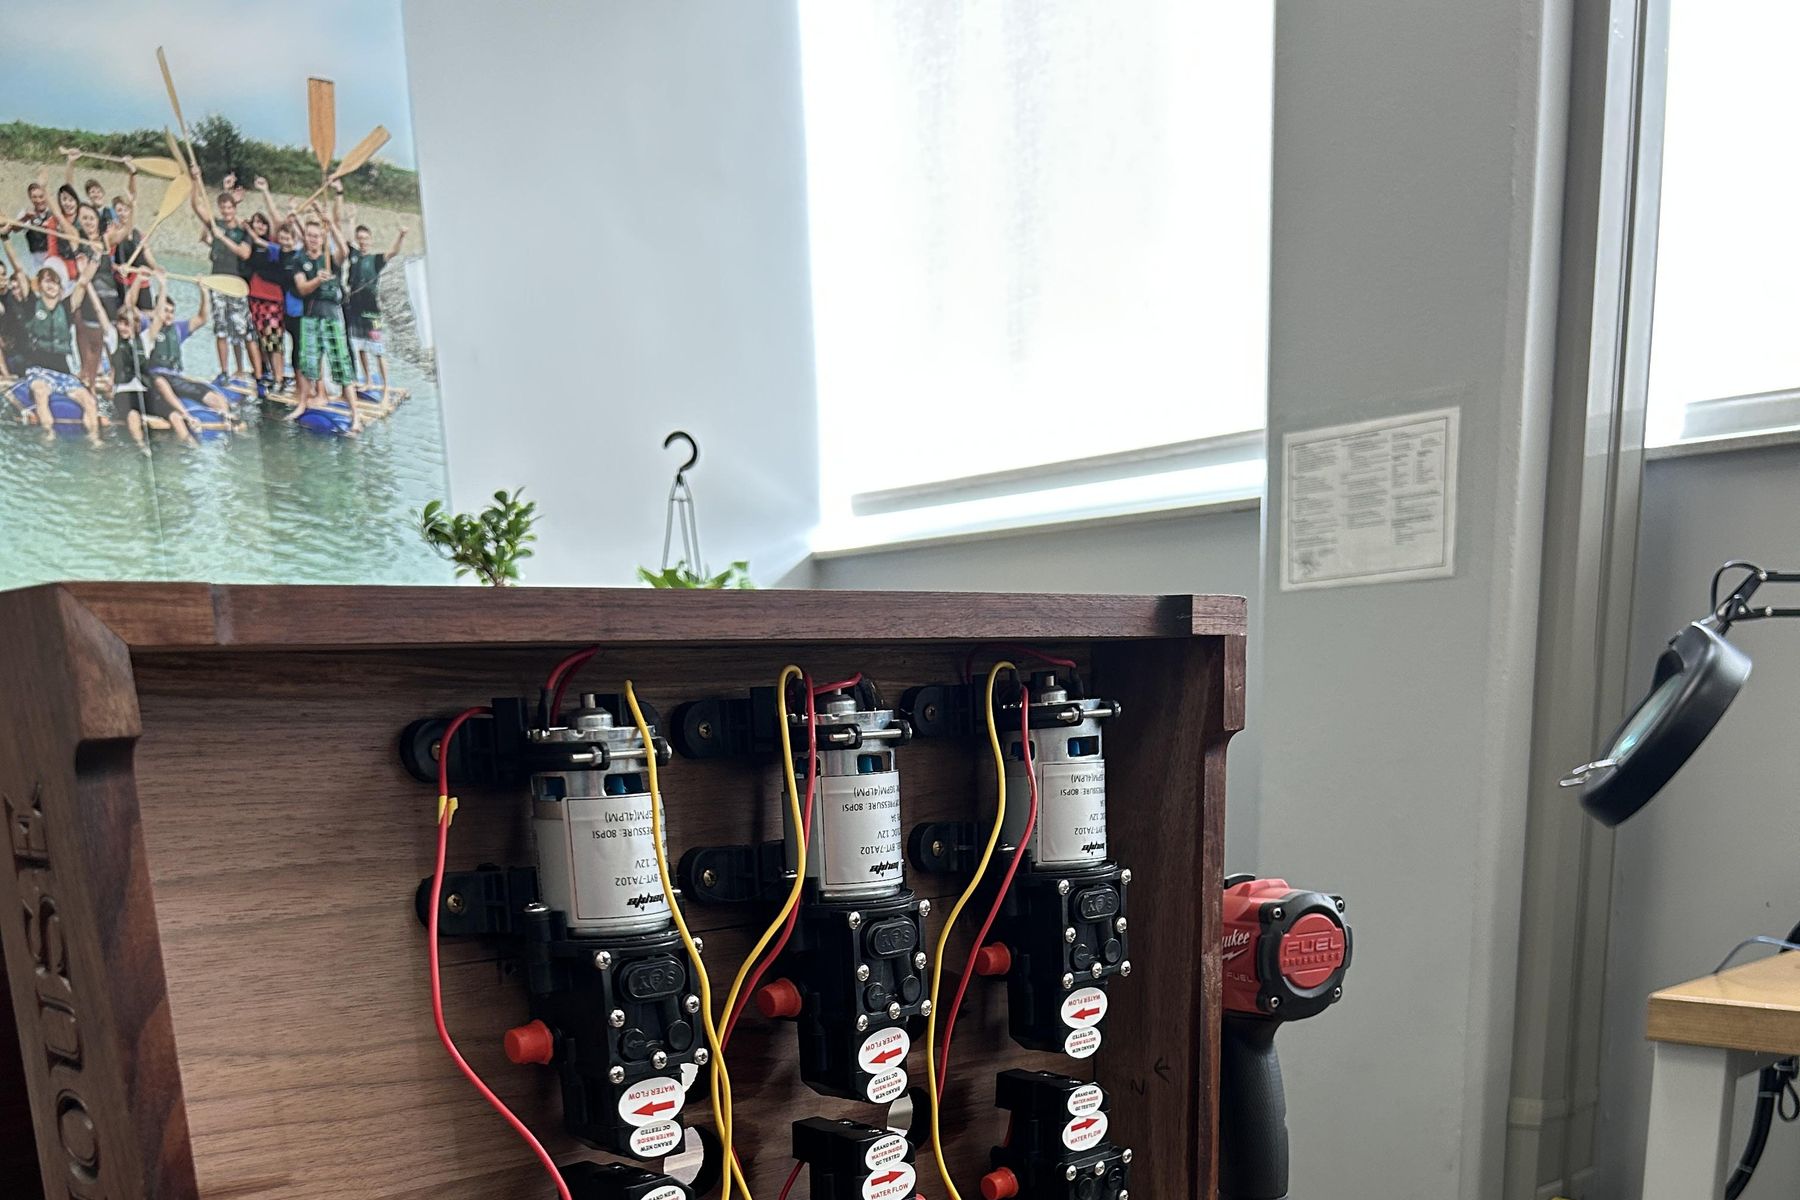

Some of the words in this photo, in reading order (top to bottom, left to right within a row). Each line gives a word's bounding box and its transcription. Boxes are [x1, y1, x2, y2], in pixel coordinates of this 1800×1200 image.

[842, 804, 864, 812] 80PSI
[592, 830, 617, 839] 80PSI
[878, 829, 889, 839] 12V
[635, 858, 650, 869] 12V
[615, 874, 658, 886] BYT-7A102
[1284, 936, 1342, 956] FUEL
[1226, 971, 1254, 982] FUEL
[883, 1034, 902, 1045] WATER
[866, 1042, 882, 1051] FLOW
[628, 1091, 649, 1100] FLOW
[650, 1085, 676, 1096] WATER
[641, 1127, 661, 1135] TESTED
[637, 1136, 655, 1144] INSIDE
[1071, 1135, 1087, 1144] WATER
[1088, 1129, 1101, 1138] FLOW
[654, 1140, 672, 1148] BRAND
[874, 1143, 889, 1152] BRAND
[872, 1151, 887, 1160] WATER
[888, 1145, 902, 1153] INSIDE
[883, 1154, 900, 1163] TESTED
[871, 1189, 891, 1200] WATER
[892, 1184, 908, 1193] FLOW
